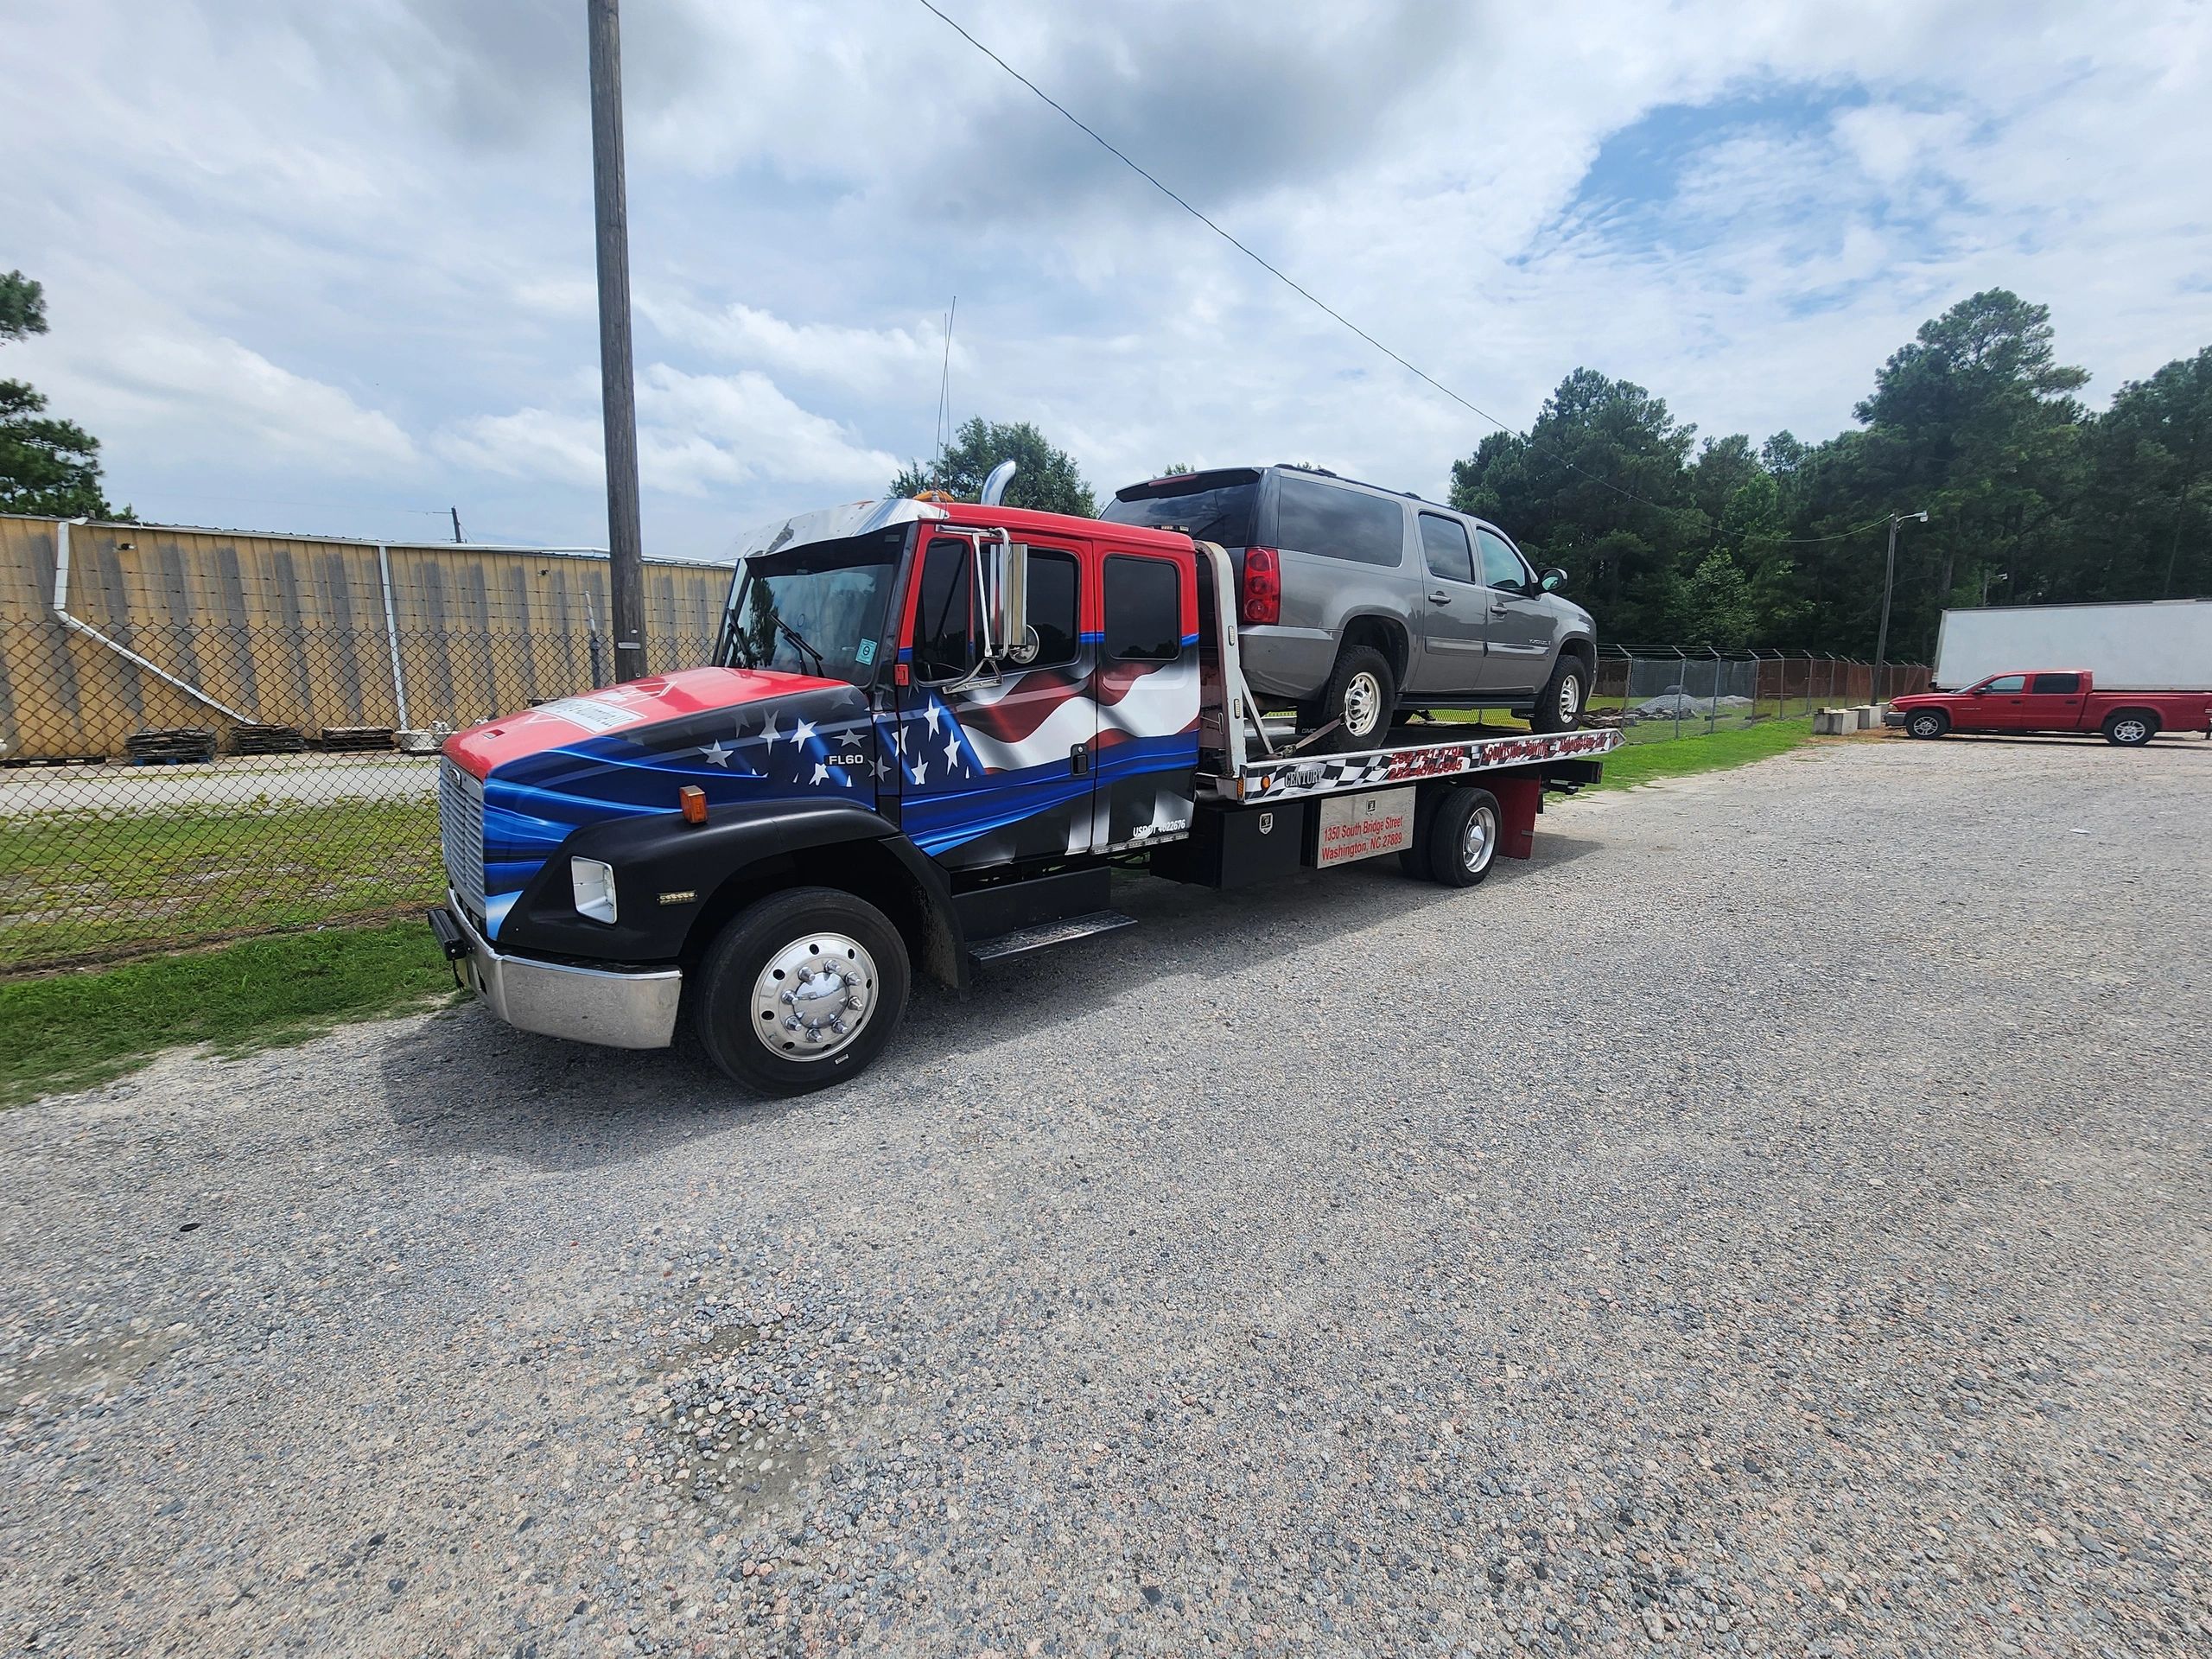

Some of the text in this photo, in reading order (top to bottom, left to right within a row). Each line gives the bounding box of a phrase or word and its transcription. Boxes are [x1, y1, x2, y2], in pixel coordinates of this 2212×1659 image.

[829, 754, 864, 765] FL60
[1285, 769, 1322, 787] CENTURY
[1324, 816, 1403, 842] 1350 South Bridge Street
[1321, 832, 1402, 861] Washington, NC 27889
